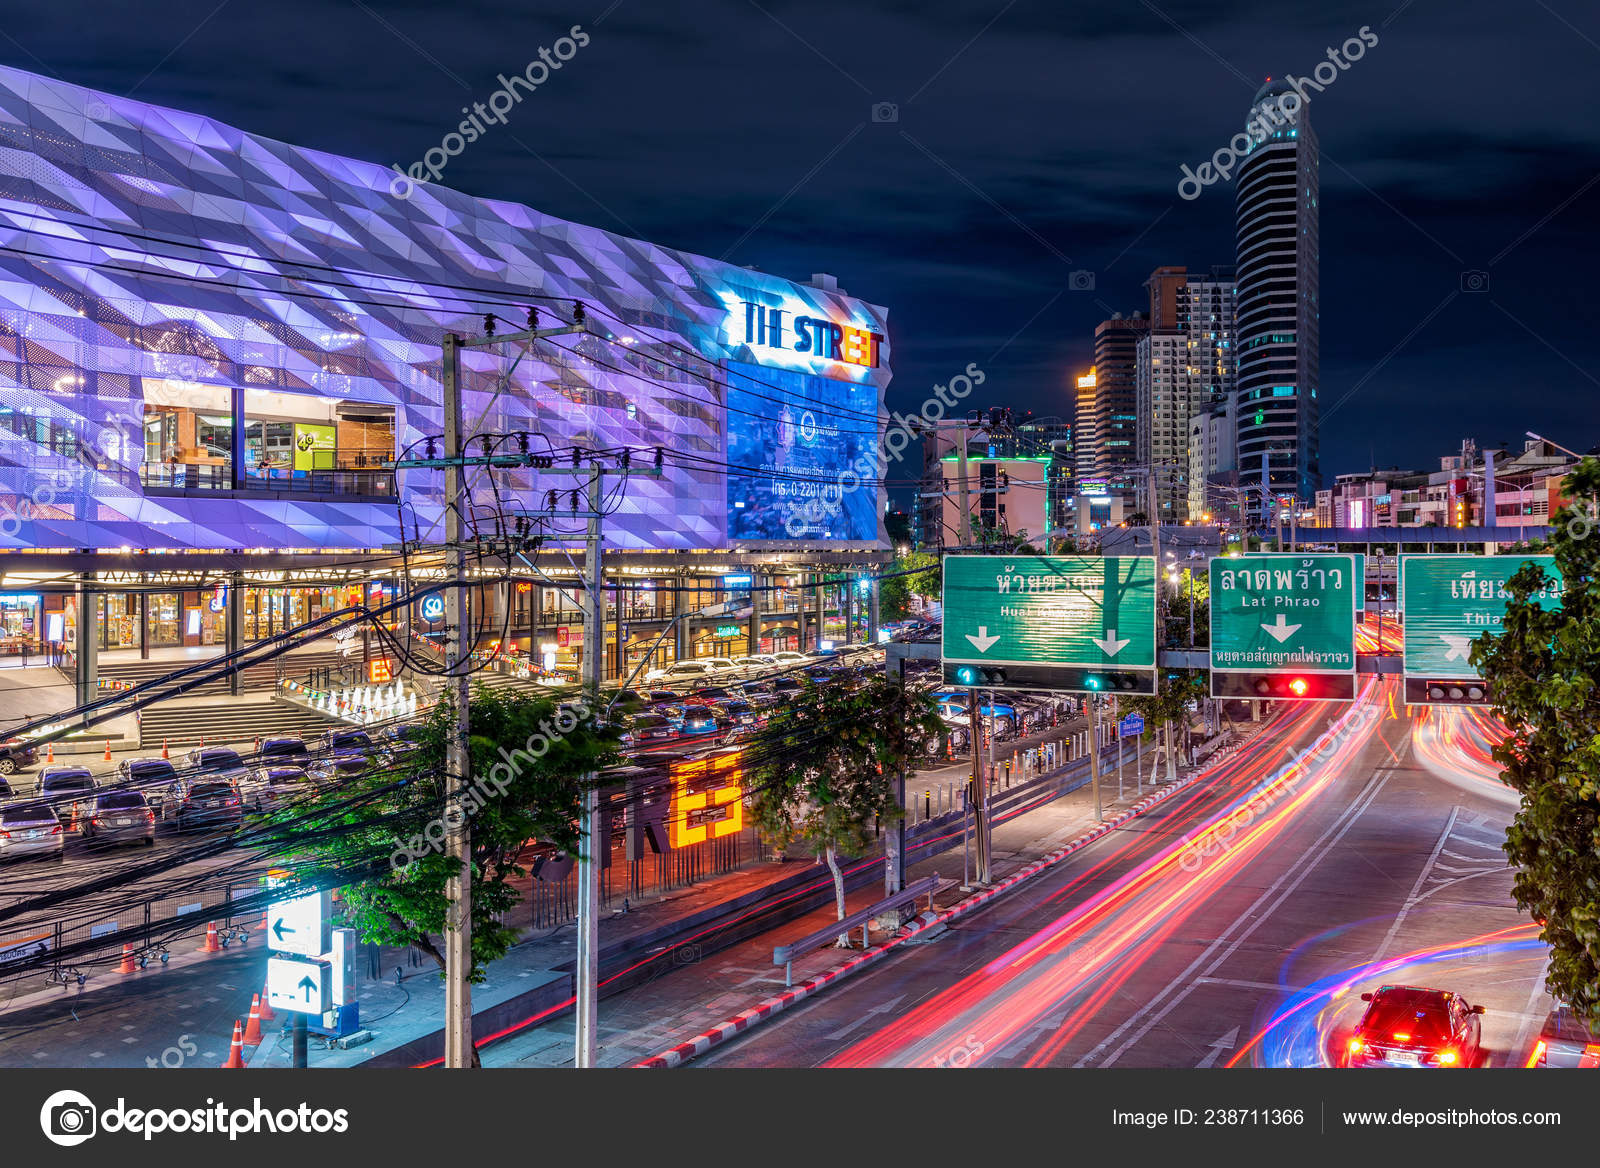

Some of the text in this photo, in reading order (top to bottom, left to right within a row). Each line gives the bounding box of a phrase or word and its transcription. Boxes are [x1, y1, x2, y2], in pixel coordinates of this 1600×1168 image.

[739, 301, 884, 368] THE STREET
[800, 482, 820, 497] 2201
[1220, 560, 1342, 590] ลาดพร้าว
[1242, 596, 1320, 607] Lat Phrao
[1463, 612, 1506, 625] Thia
[1216, 646, 1349, 665] หยุดรอสัญญาณไฟจราจร
